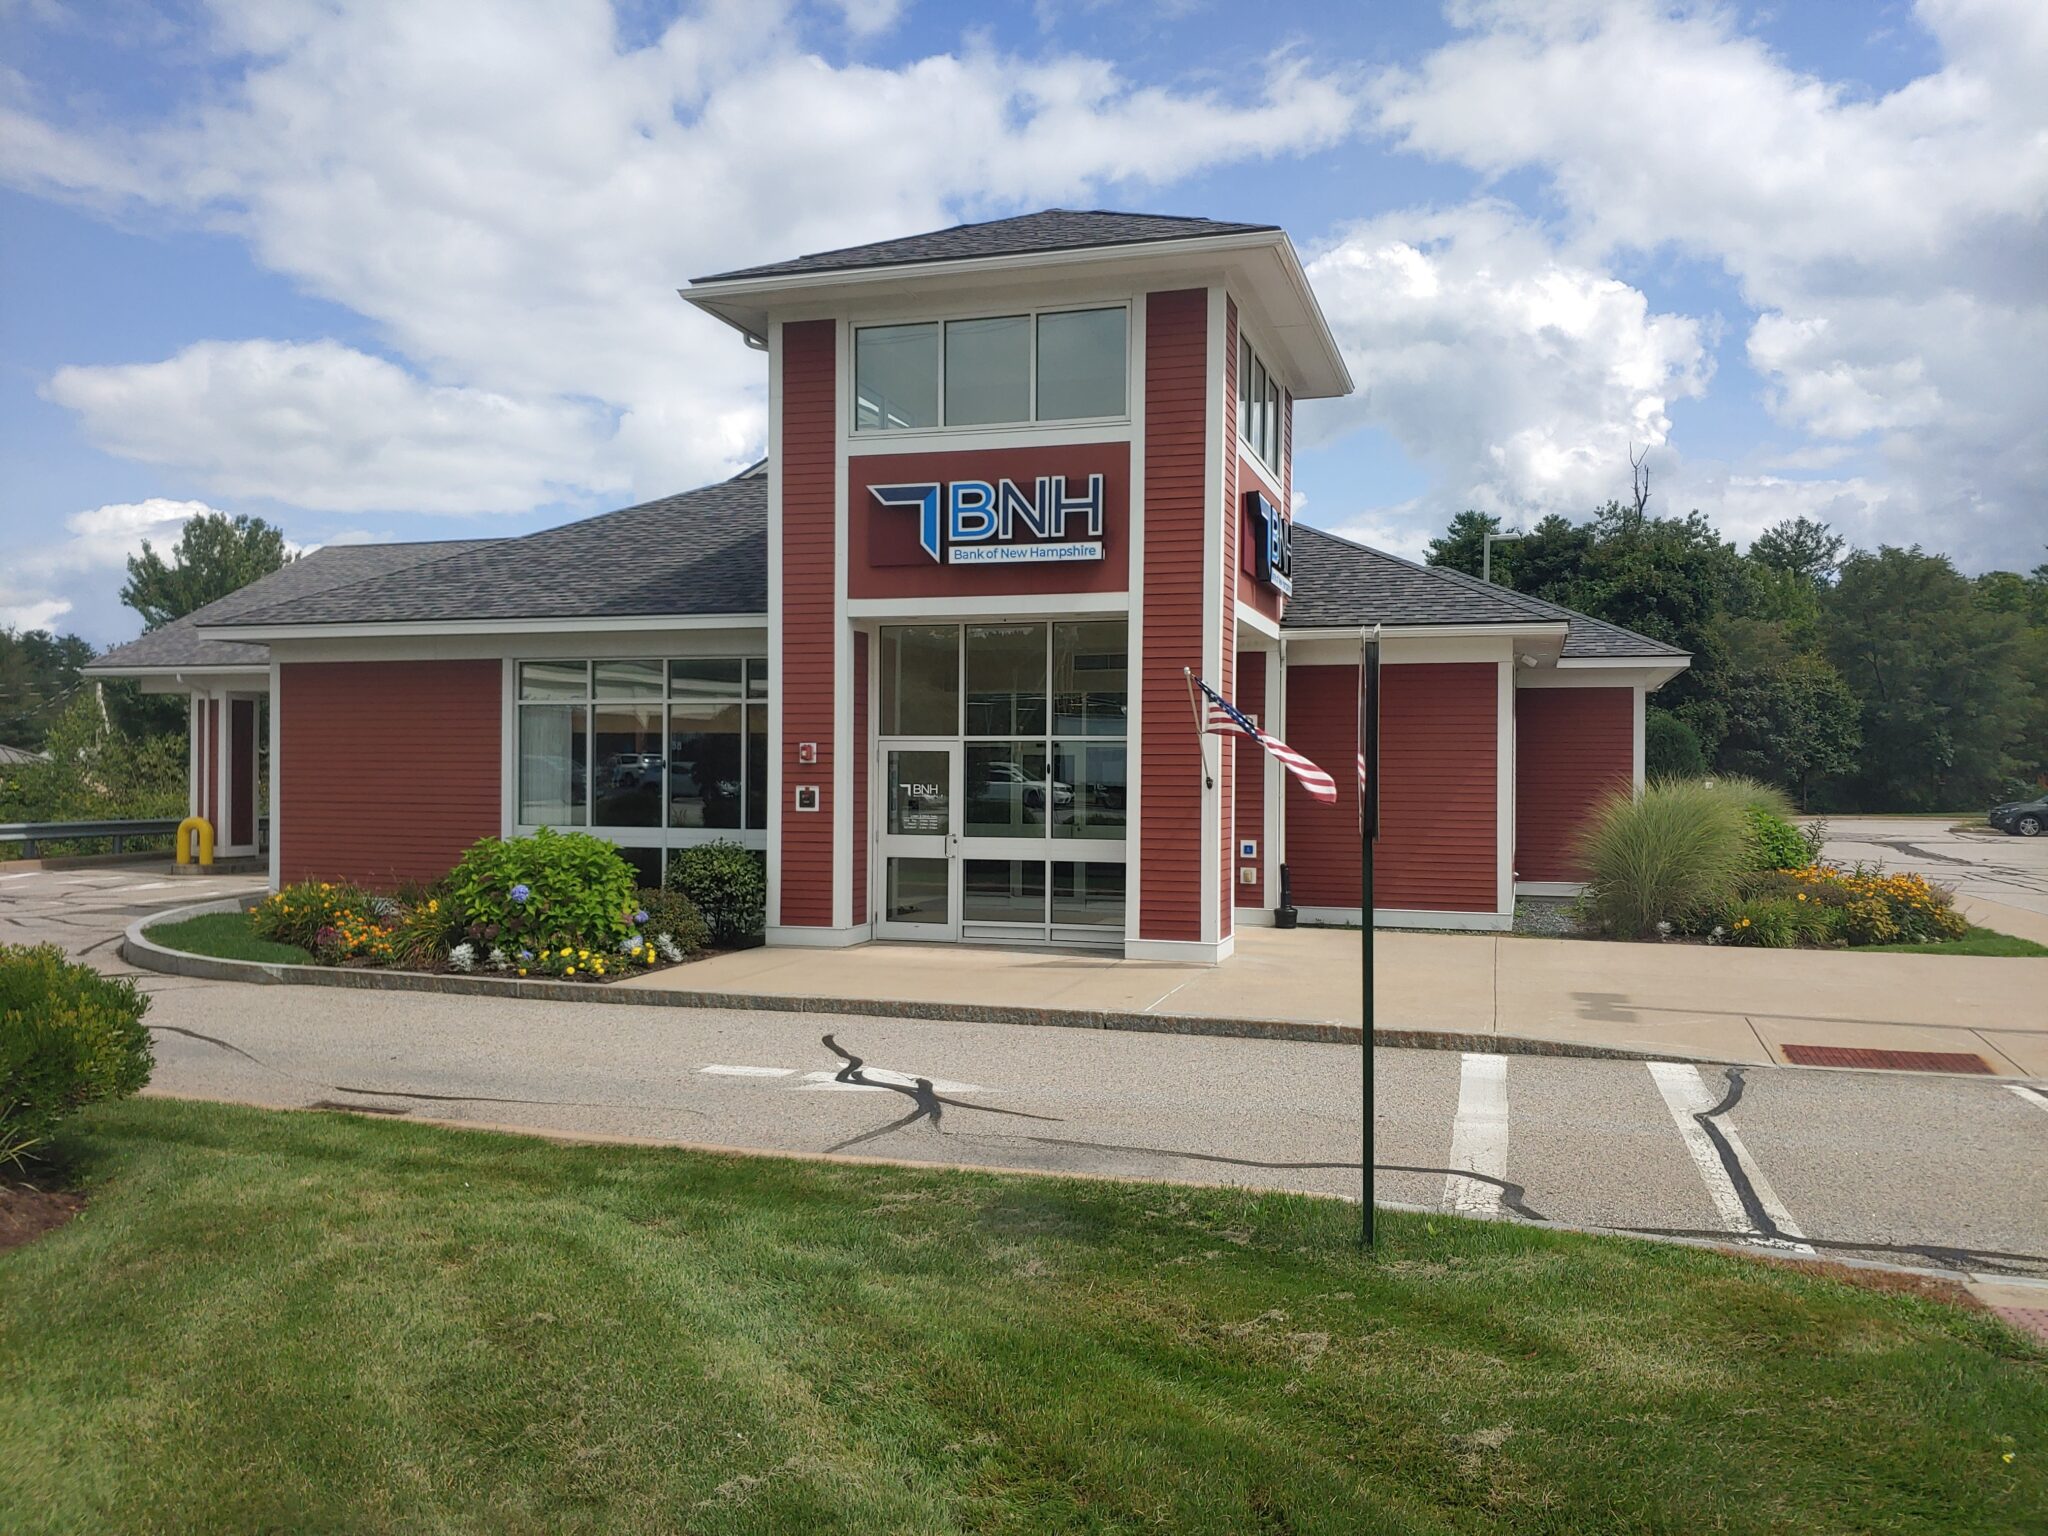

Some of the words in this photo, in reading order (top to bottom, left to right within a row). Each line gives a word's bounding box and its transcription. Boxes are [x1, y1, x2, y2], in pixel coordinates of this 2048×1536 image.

[949, 473, 1103, 541] BNH
[954, 548, 985, 560] Bank
[986, 548, 998, 559] of
[1000, 547, 1028, 559] New
[1030, 545, 1096, 559] Hampshire
[1272, 506, 1292, 577] BNH
[913, 784, 938, 794] BNH
